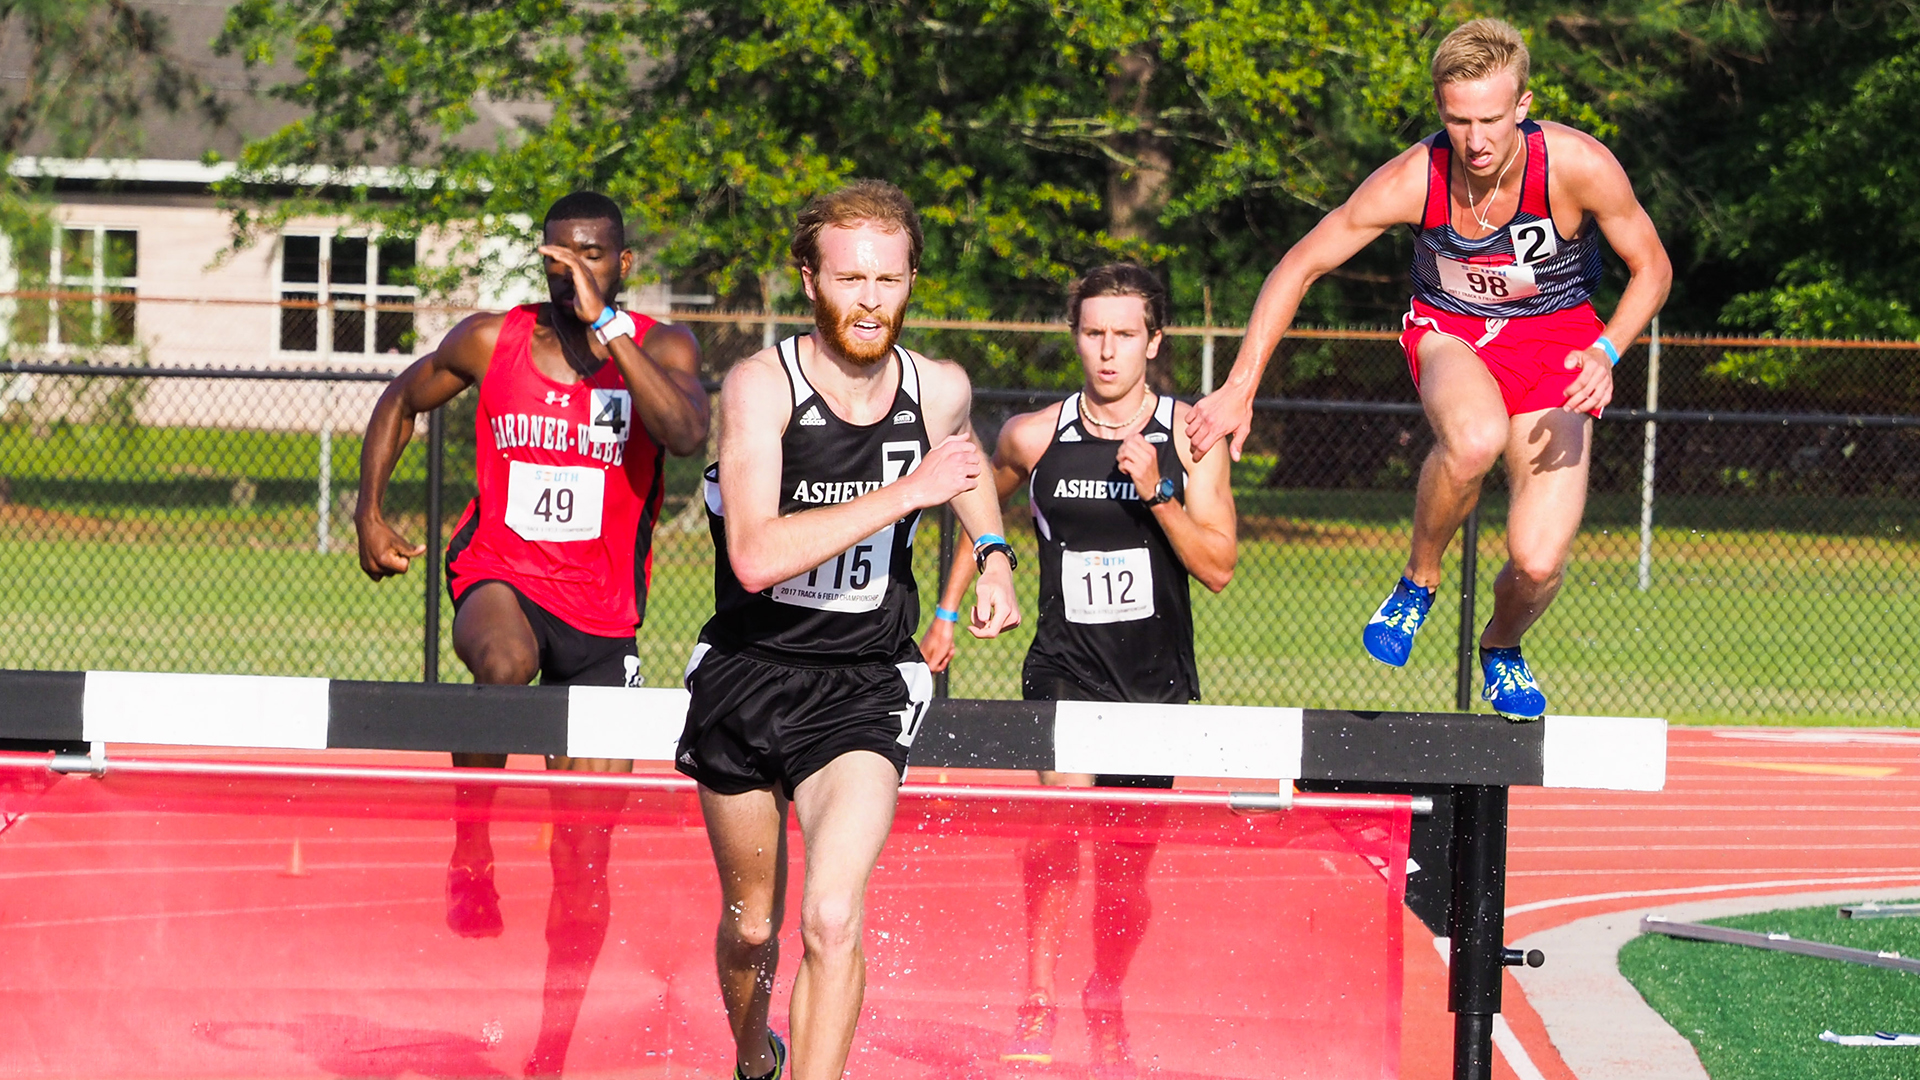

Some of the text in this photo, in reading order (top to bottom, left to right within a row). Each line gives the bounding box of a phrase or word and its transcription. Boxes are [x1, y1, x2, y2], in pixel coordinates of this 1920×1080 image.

[1517, 226, 1551, 264] 2
[1461, 264, 1507, 277] SOUTH
[1466, 272, 1509, 297] 98
[594, 397, 626, 434] 4
[535, 470, 579, 482] SOUTH
[887, 450, 916, 480] 7
[533, 488, 574, 523] 49
[1084, 556, 1126, 566] SOUTH
[781, 587, 797, 596] 2017
[797, 589, 816, 599] TRACK
[822, 592, 839, 600] FIELD
[839, 594, 879, 602] CHAMPIONSHIP
[1082, 570, 1136, 605] 112
